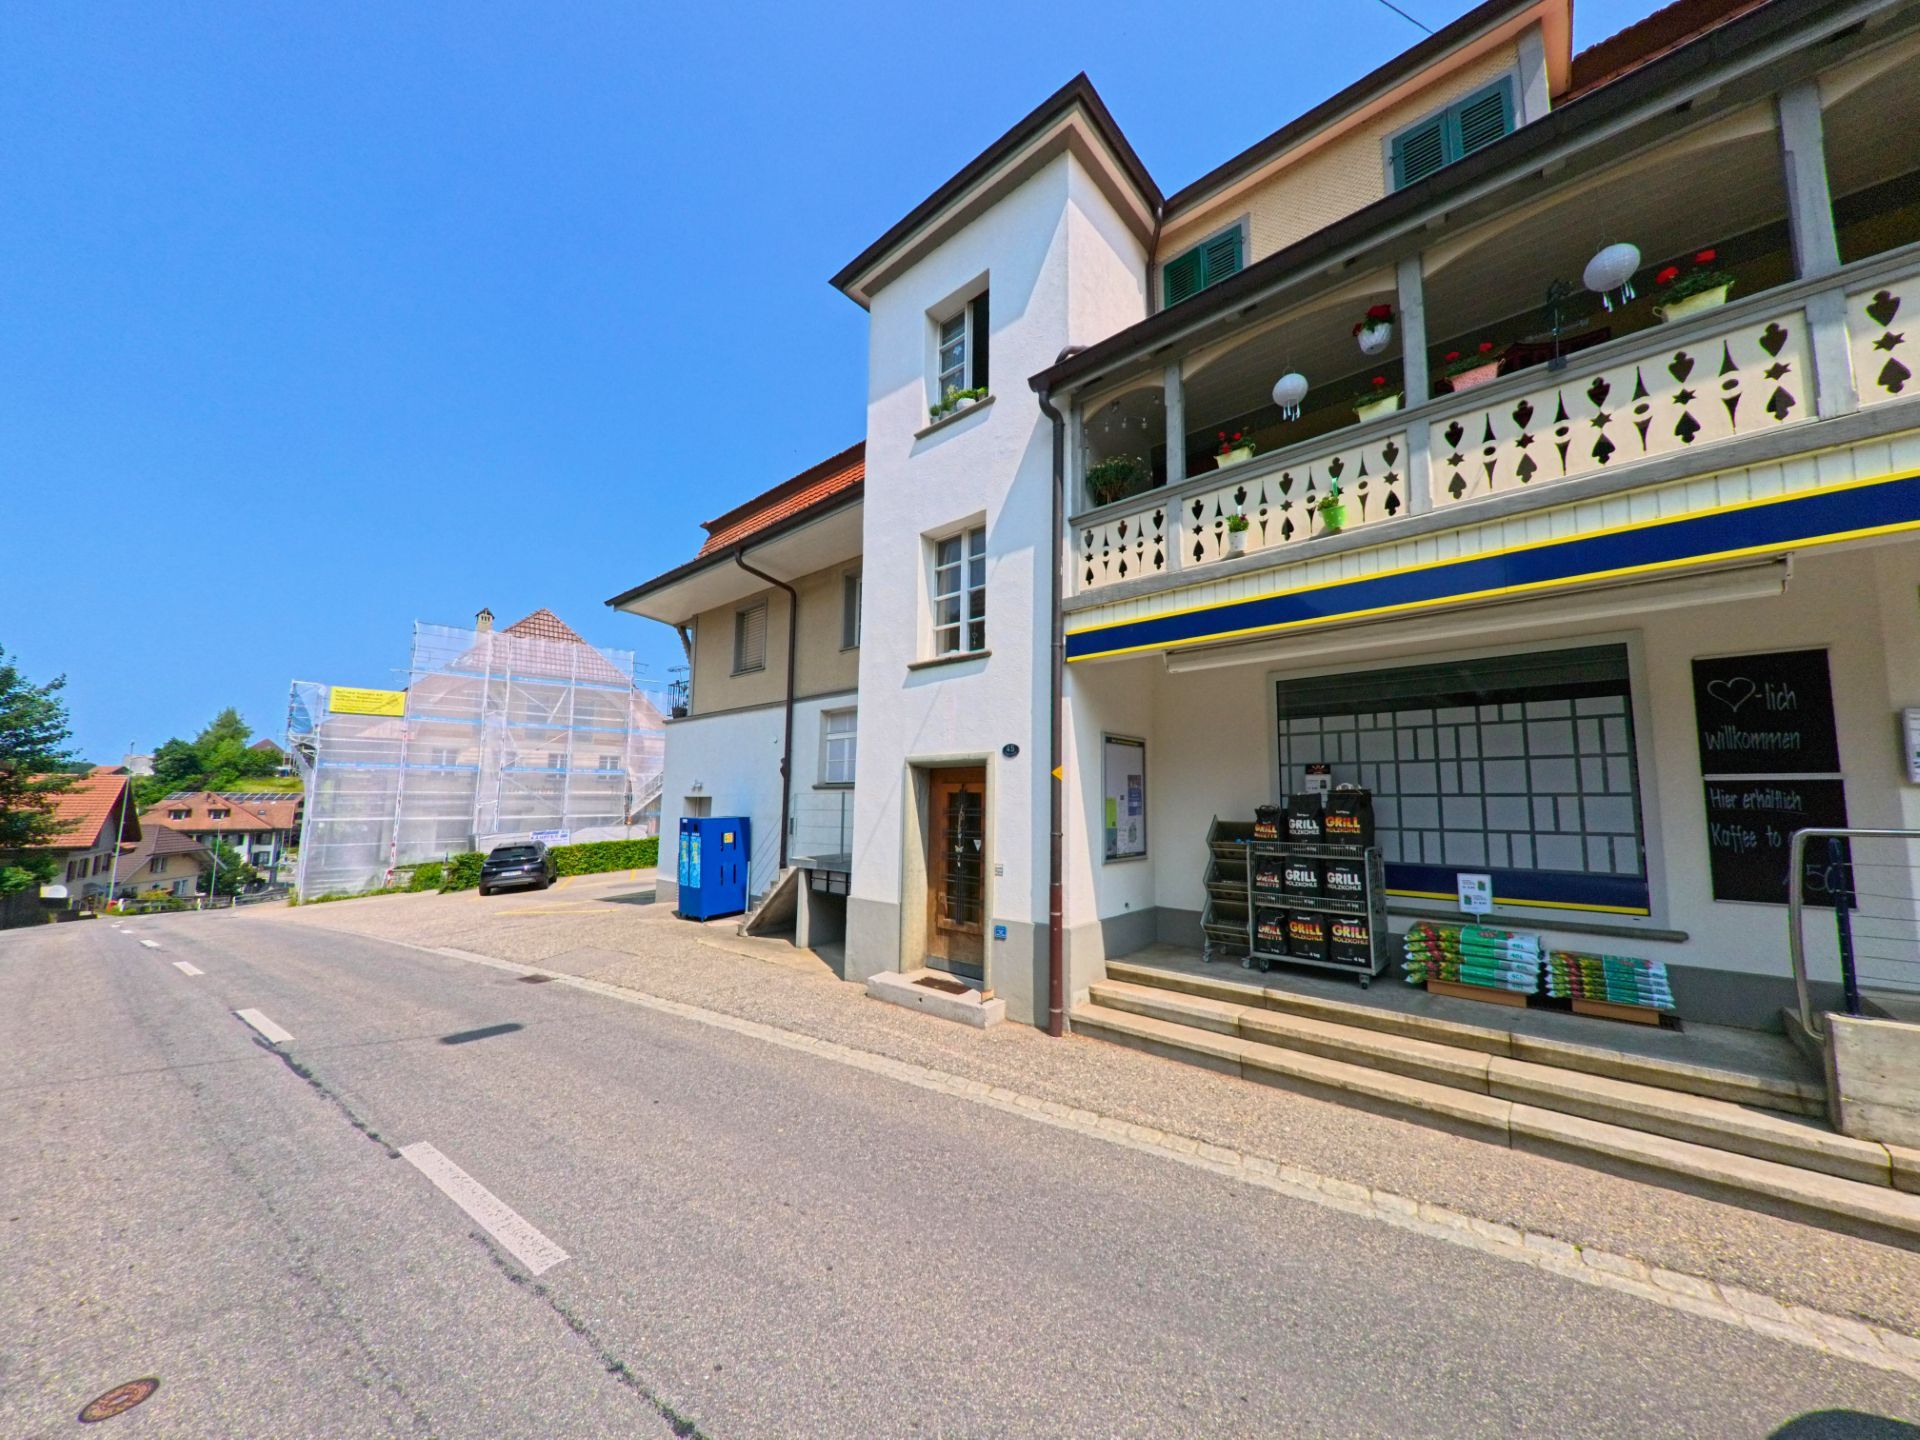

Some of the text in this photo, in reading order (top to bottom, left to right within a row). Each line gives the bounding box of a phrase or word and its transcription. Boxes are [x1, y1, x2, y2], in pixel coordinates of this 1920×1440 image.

[1704, 725, 1801, 750] willkommen
[1710, 786, 1737, 809] Hier
[1289, 818, 1320, 829] GRILL
[1325, 816, 1361, 828] GRILL
[1711, 822, 1758, 854] Kaffee
[1765, 825, 1782, 848] to
[1285, 869, 1318, 882] GRILL
[1327, 872, 1362, 885] GRILL
[1257, 925, 1282, 935] GRILL
[1290, 921, 1323, 935] GRILL
[1332, 924, 1369, 939] GRILL
